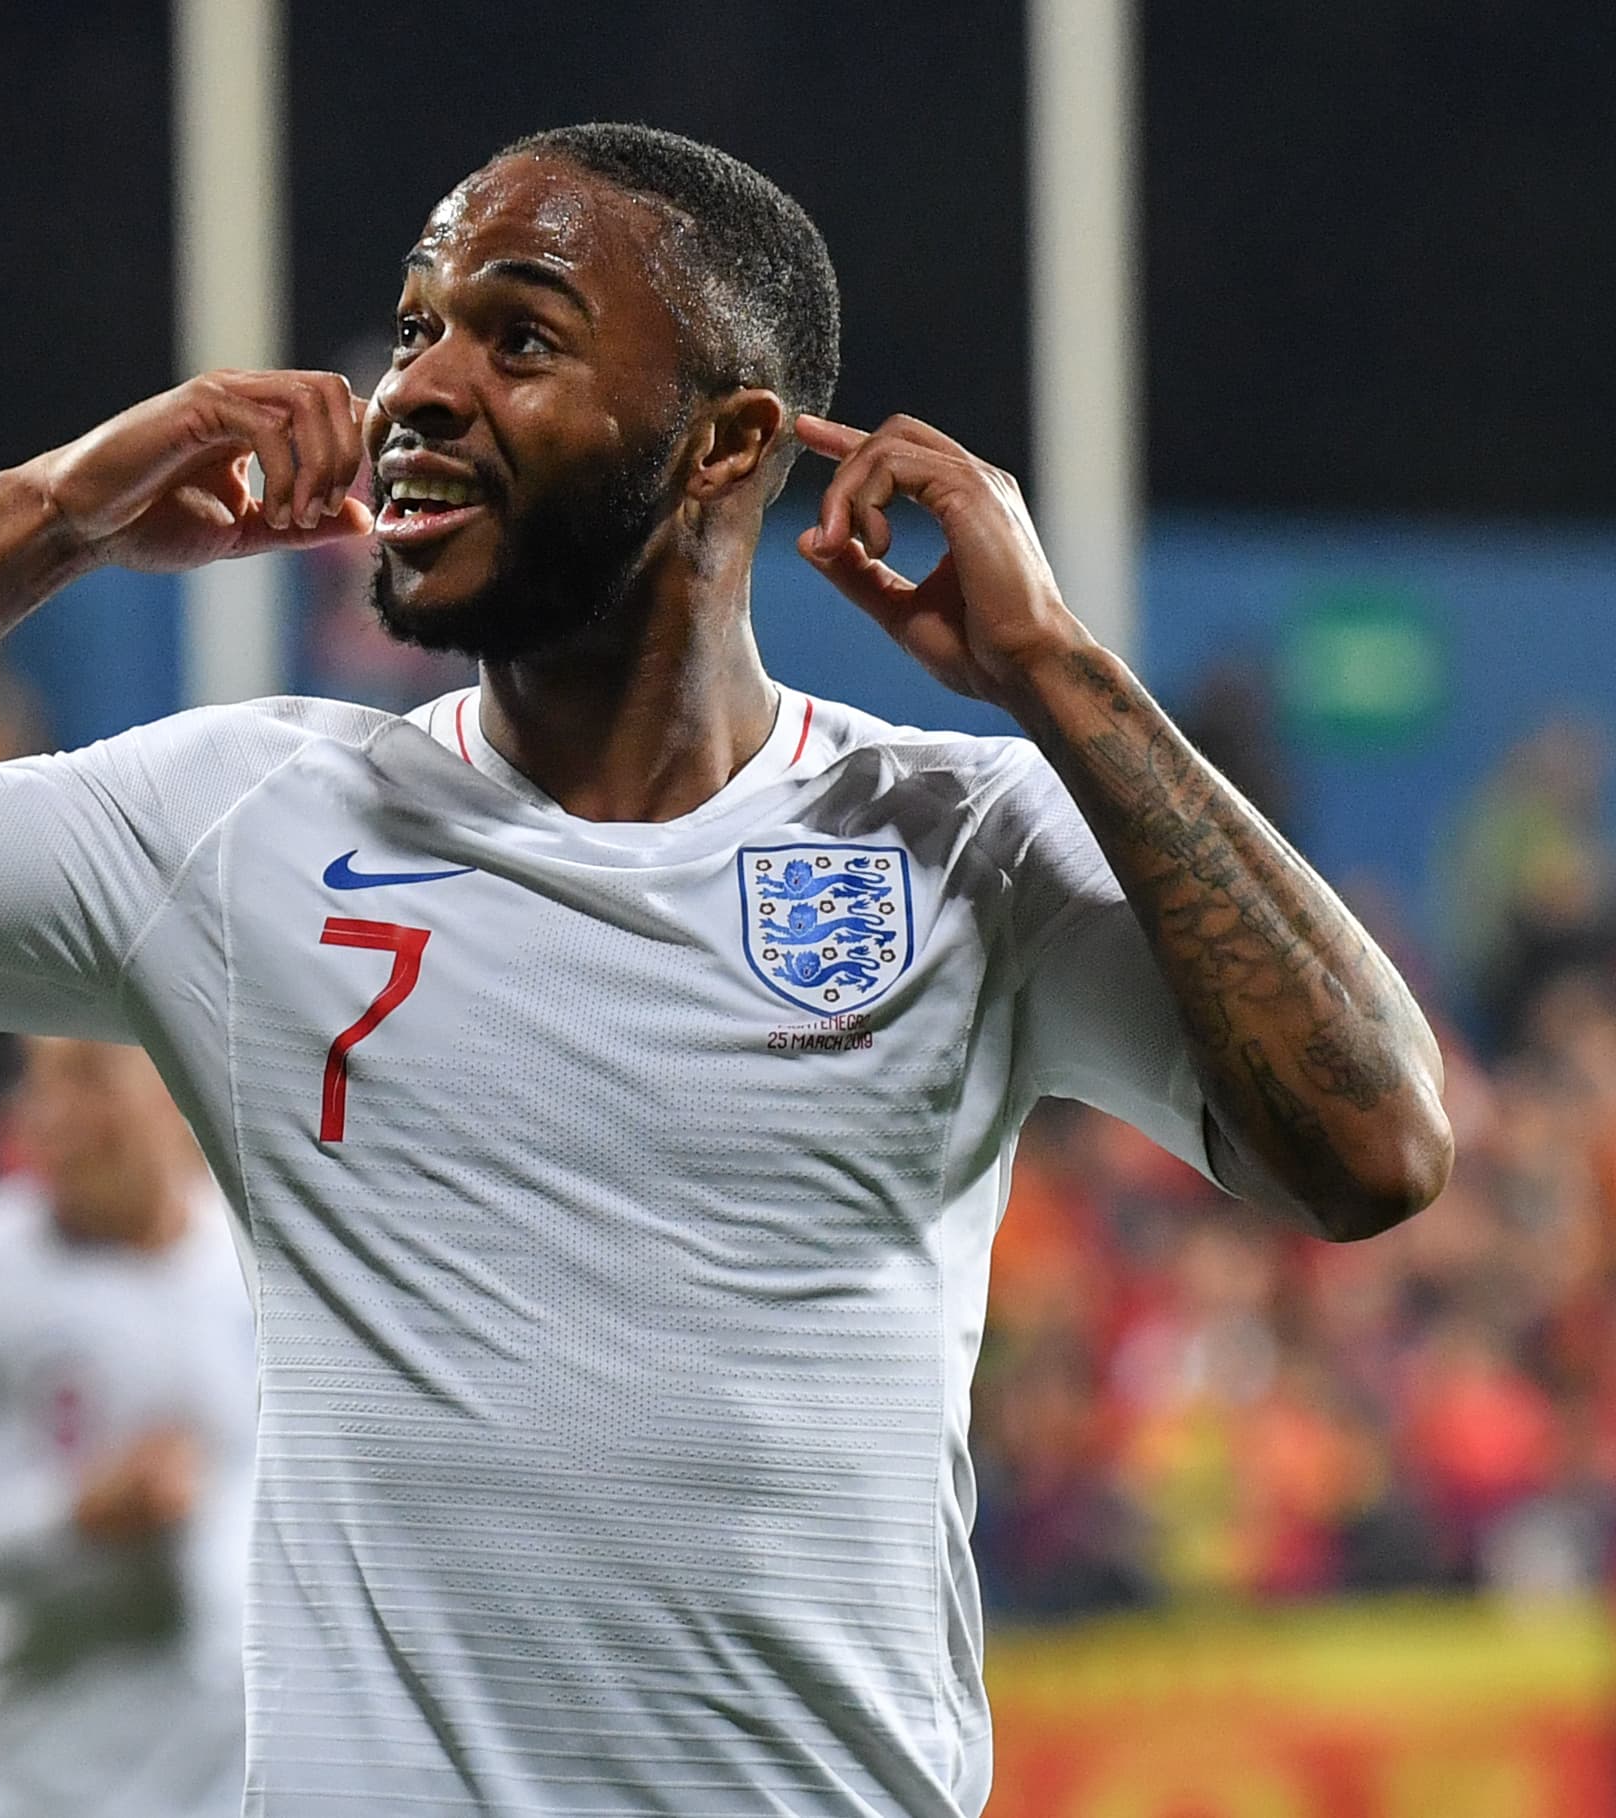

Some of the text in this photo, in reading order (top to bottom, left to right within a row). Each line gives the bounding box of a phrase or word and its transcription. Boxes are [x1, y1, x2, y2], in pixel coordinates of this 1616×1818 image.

[319, 916, 432, 1142] 7
[767, 1031, 873, 1051] 25 MARCH 2019
